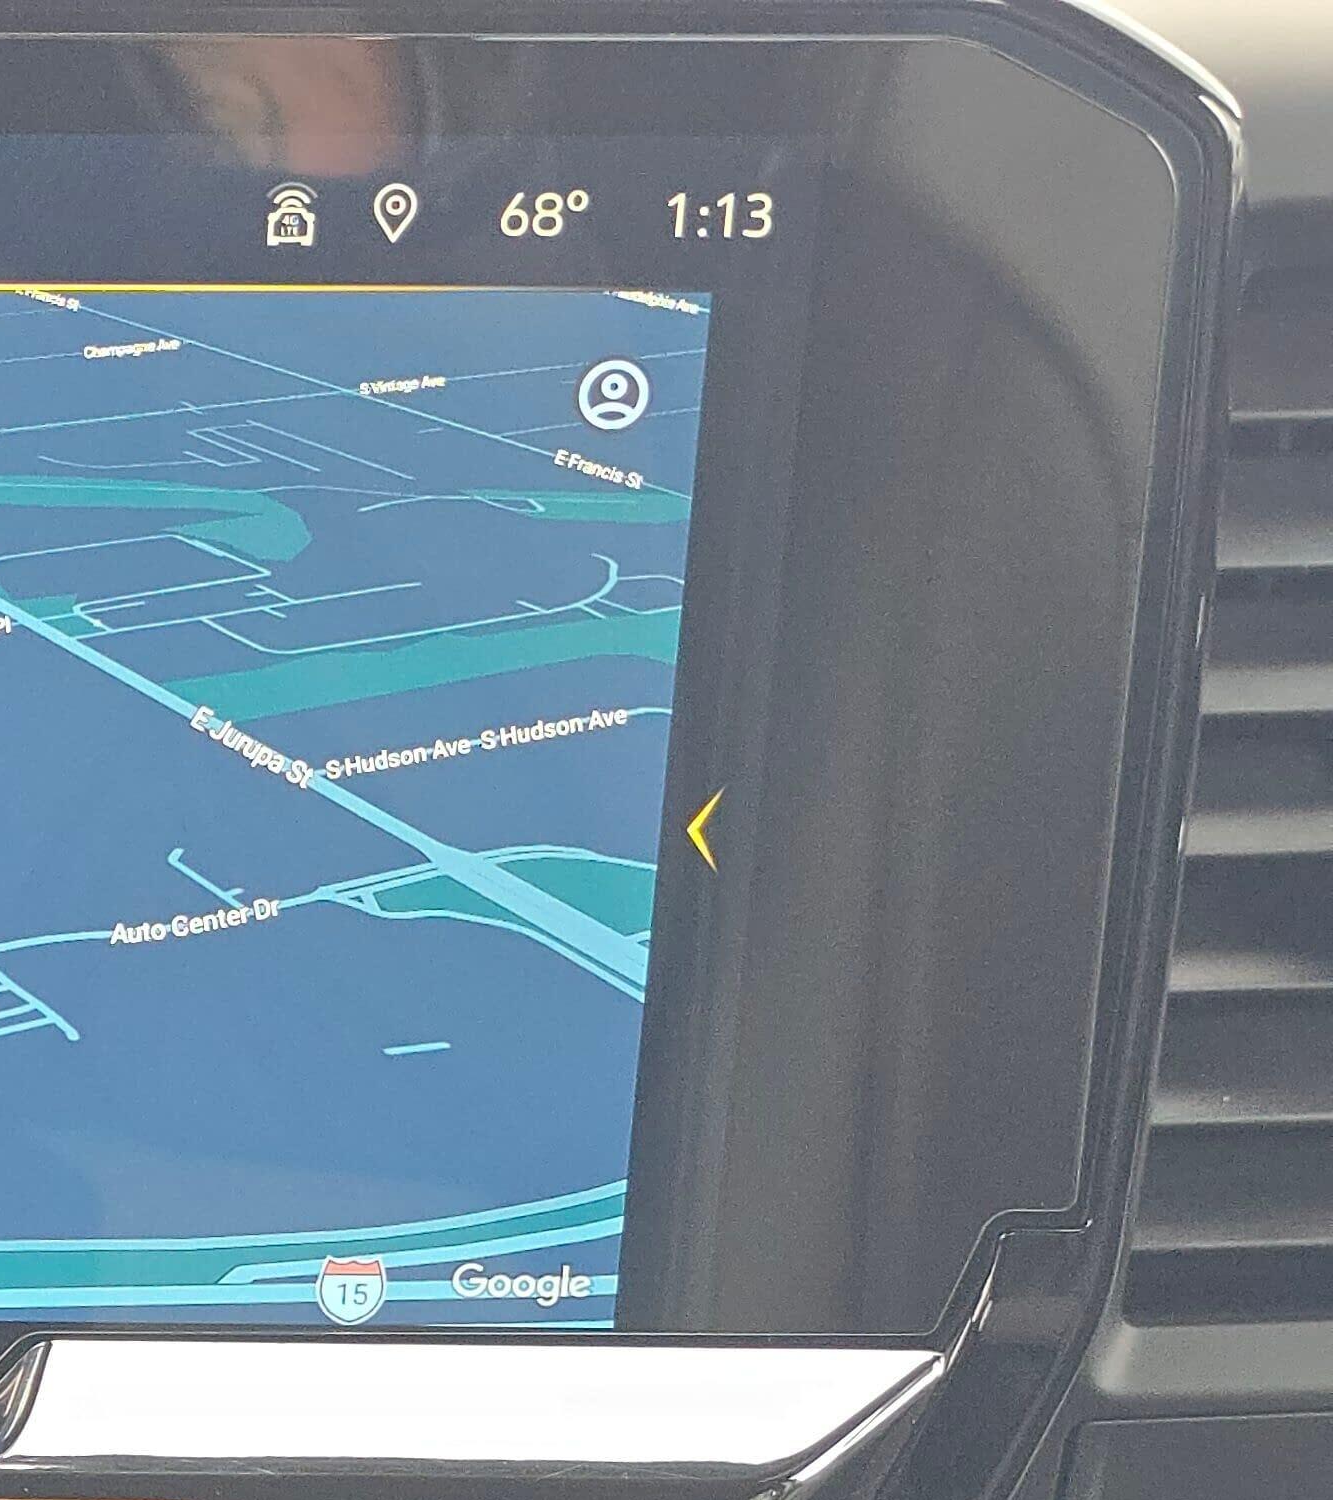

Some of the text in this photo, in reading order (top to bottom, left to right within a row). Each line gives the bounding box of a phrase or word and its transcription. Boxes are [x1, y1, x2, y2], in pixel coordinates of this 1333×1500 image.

[500, 189, 590, 237] 68°
[667, 192, 773, 238] 1:13
[83, 338, 182, 360] Champagne Ave
[420, 374, 447, 390] Ave
[554, 449, 644, 491] E Francis St
[189, 705, 315, 789] E Jurupa St
[479, 707, 629, 752] S Hudson Ave
[324, 738, 472, 781] S Hudson Ave
[110, 897, 280, 945] Auto Center Dr
[337, 1283, 369, 1306] 15
[450, 1261, 594, 1308] Google
